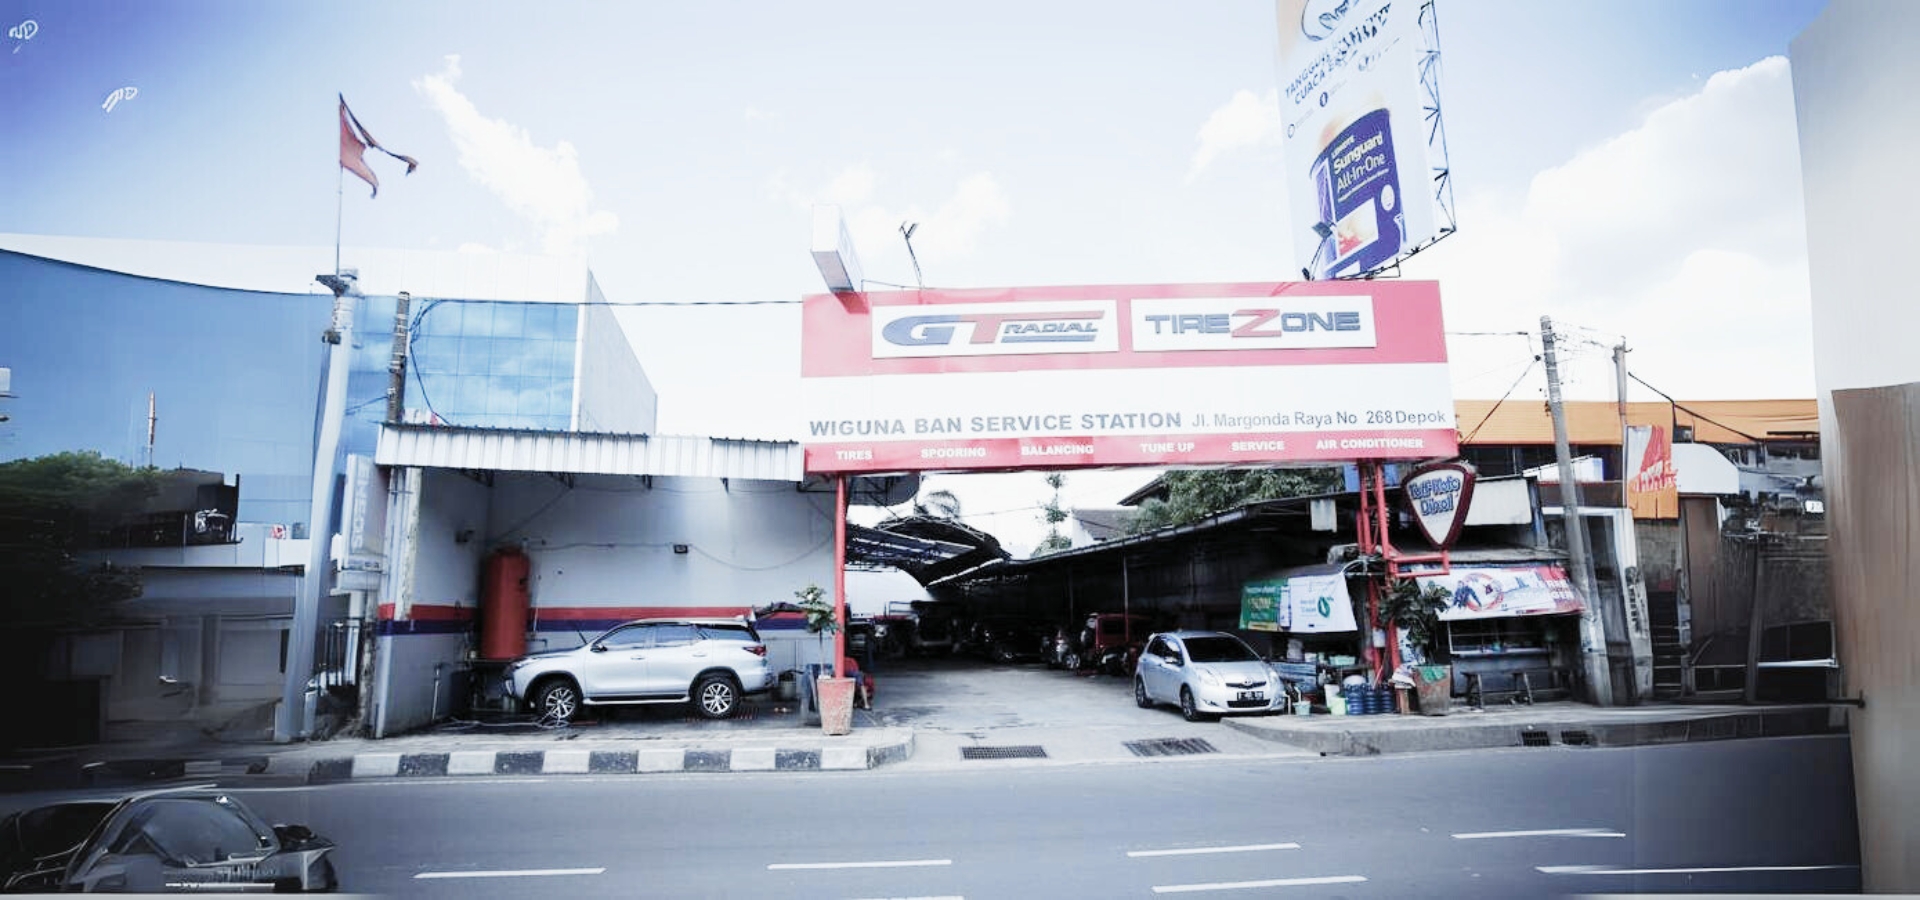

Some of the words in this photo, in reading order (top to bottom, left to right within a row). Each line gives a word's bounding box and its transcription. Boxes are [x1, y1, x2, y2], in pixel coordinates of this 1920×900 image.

[1003, 321, 1098, 334] RADIAL
[809, 419, 906, 437] WIGUNA
[914, 417, 962, 434] BAN
[970, 415, 1072, 433] SERVICE
[1081, 412, 1182, 430] STATION
[1214, 412, 1291, 428] Margonda
[1294, 411, 1333, 428] Raya
[1336, 411, 1358, 425] No
[1366, 410, 1393, 424] 268
[1395, 410, 1447, 424] Depok
[1140, 443, 1172, 453] TUNE
[1177, 442, 1195, 452] UP
[1231, 441, 1285, 451] SERVICE
[1316, 440, 1337, 450] AIR
[1341, 438, 1423, 449] CONDITIONER
[837, 450, 872, 460] TIRES
[921, 448, 986, 458] SPOORING
[1021, 445, 1094, 456] BALANCING
